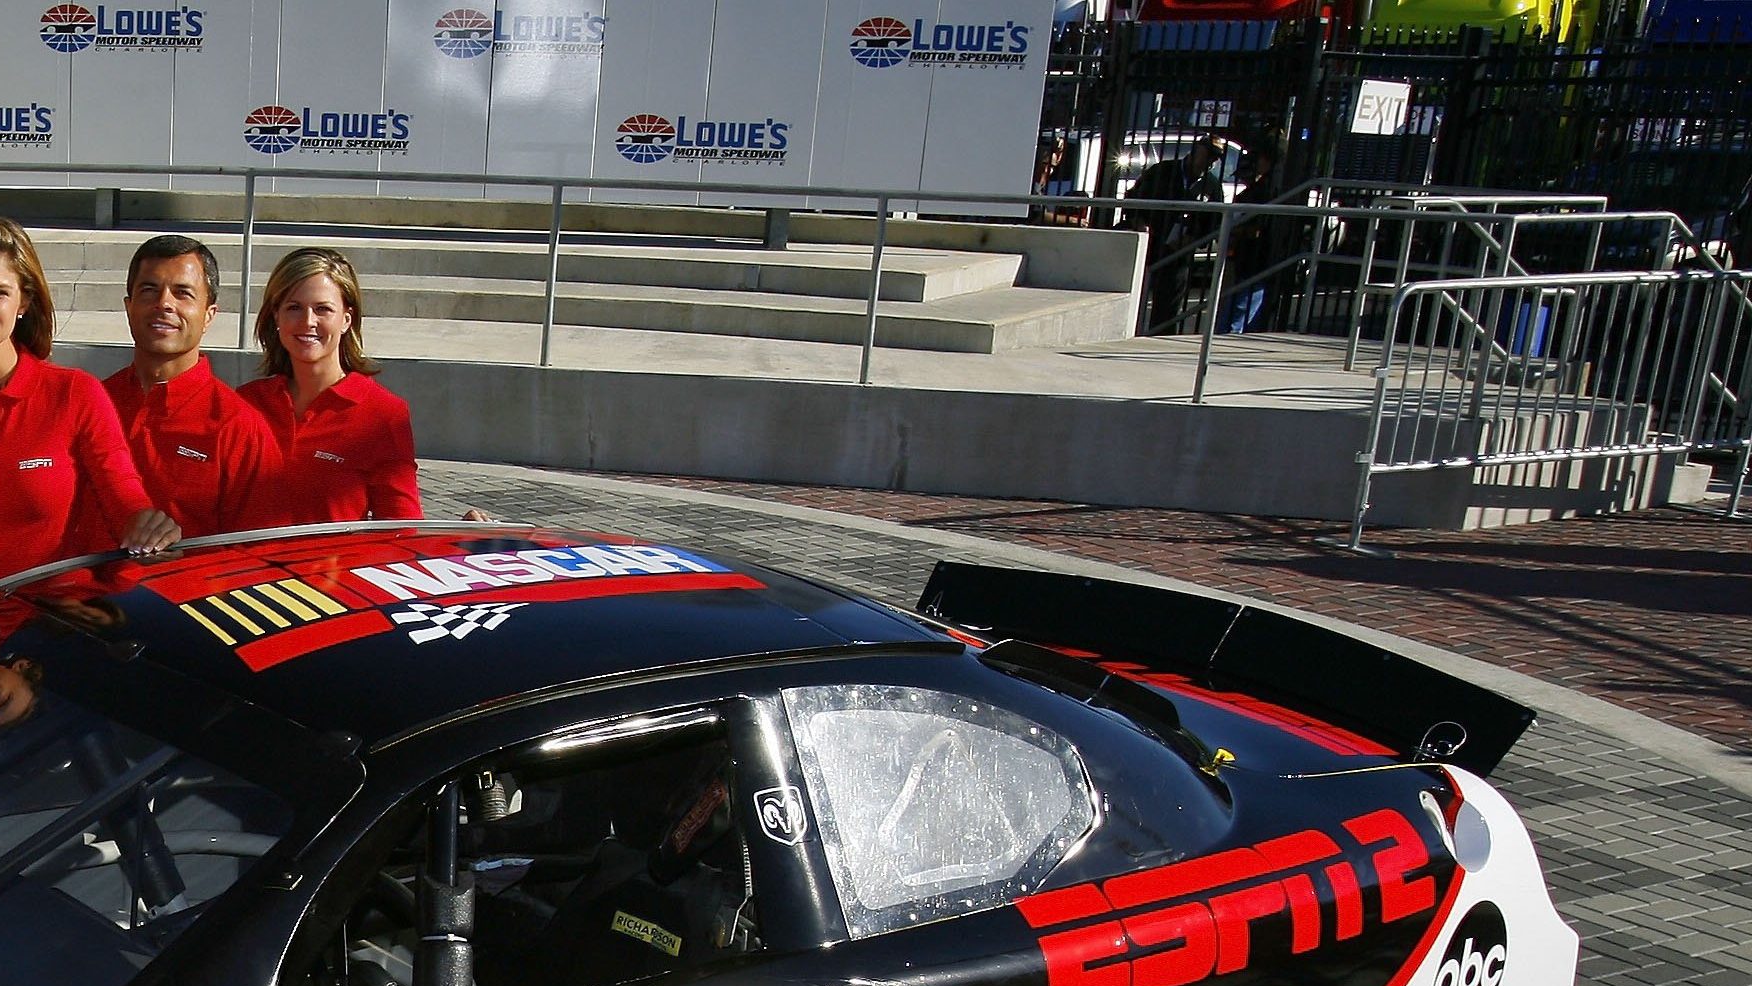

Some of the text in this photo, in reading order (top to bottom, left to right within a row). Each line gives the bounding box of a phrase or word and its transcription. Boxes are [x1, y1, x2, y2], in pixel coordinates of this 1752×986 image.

[97, 5, 203, 36] LOWE'S
[495, 10, 606, 42] LOWE'S
[96, 36, 203, 47] MOTOR SPEEDWAY
[913, 19, 1029, 52] LOWE'S
[909, 51, 1028, 63] MOTOR SPEEDWAY
[302, 107, 410, 139] LOWE'S
[1357, 95, 1406, 122] EXIT
[301, 138, 409, 149] MOTOR SPEEDWAY
[676, 116, 788, 150] LOWE'S
[673, 148, 787, 160] MOTOR SPEEDWAY
[18, 458, 53, 470] ESPN
[349, 545, 714, 601] NASCAR
